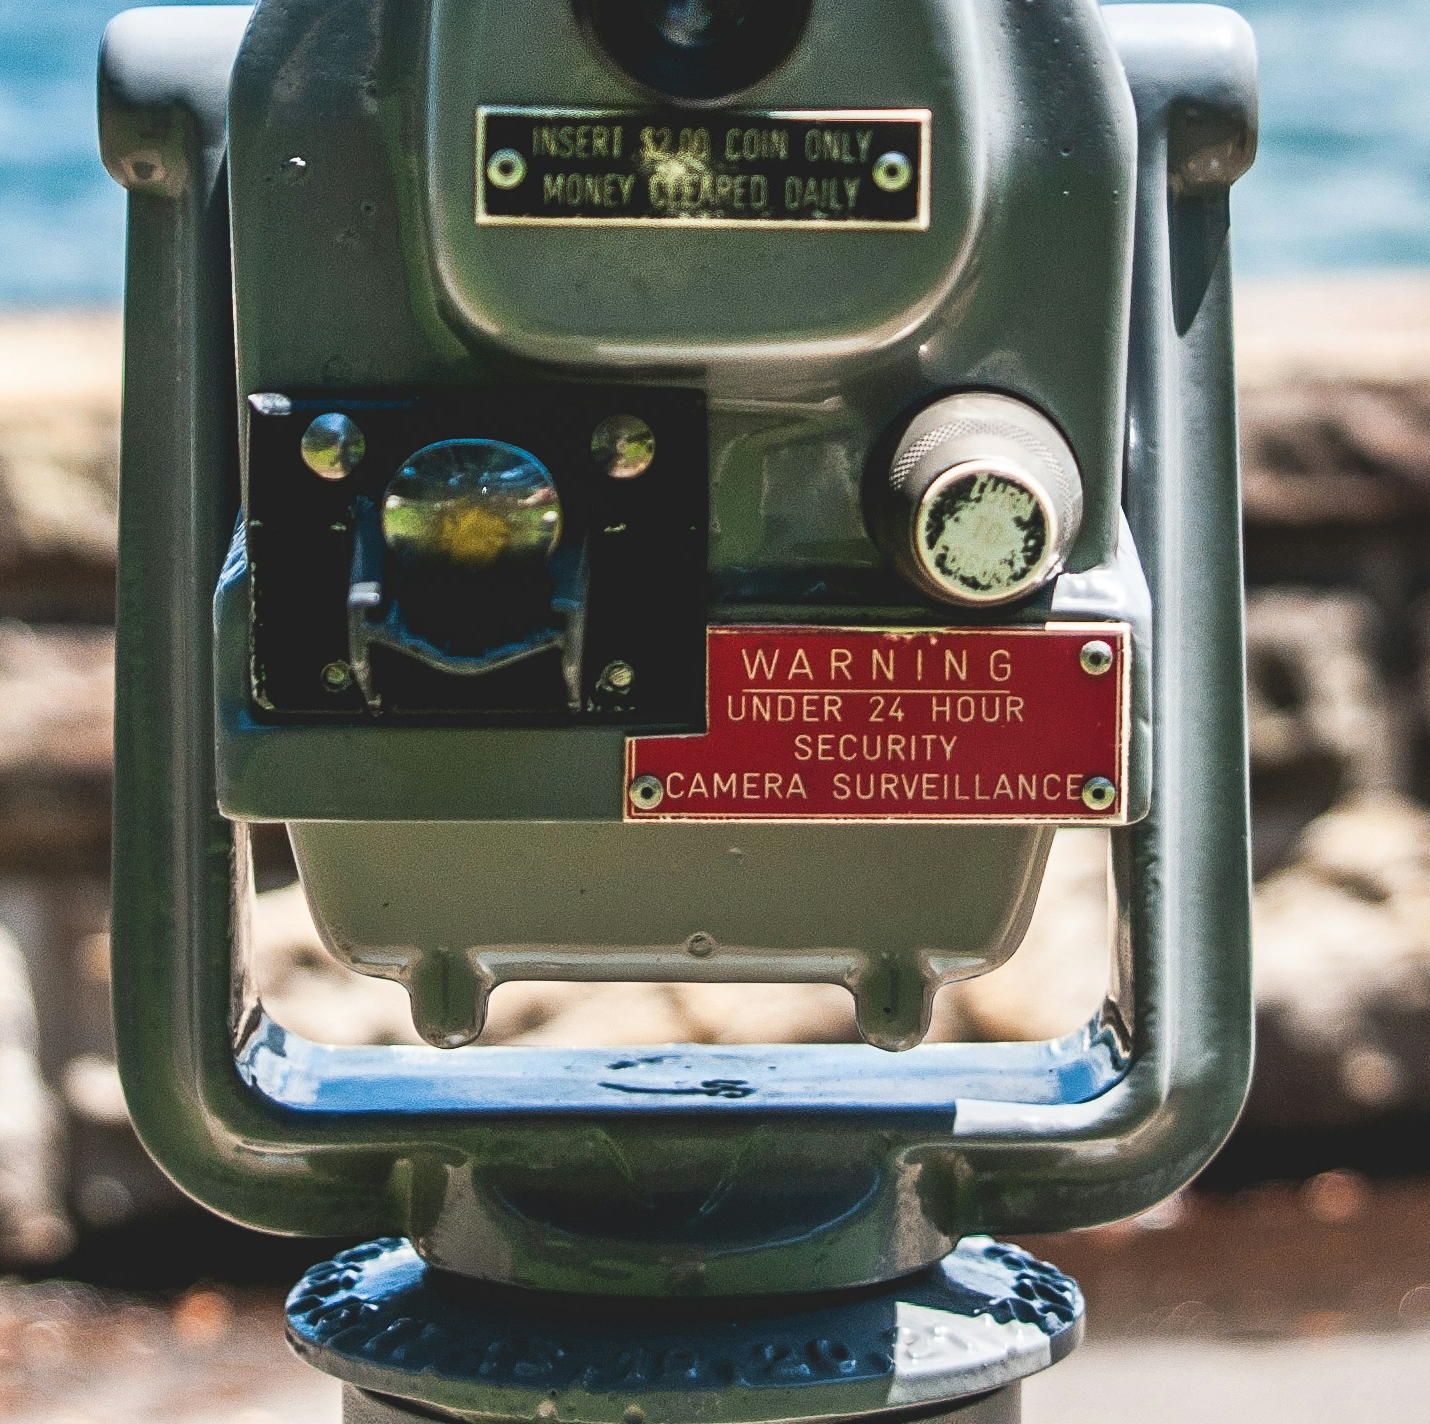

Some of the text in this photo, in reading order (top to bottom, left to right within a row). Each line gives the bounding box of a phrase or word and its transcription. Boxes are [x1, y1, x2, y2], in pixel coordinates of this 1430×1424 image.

[531, 125, 624, 161] INSERT
[724, 127, 789, 162] COIN
[803, 127, 873, 164] ONLY
[542, 173, 636, 208] MONEY
[784, 175, 862, 211] DAILY
[741, 648, 1013, 683] WARNING
[726, 695, 1026, 724] UNDER 24 HOUR
[793, 733, 959, 762] SECURITY
[666, 773, 1083, 802] CAMERA SURVEILLANCE
